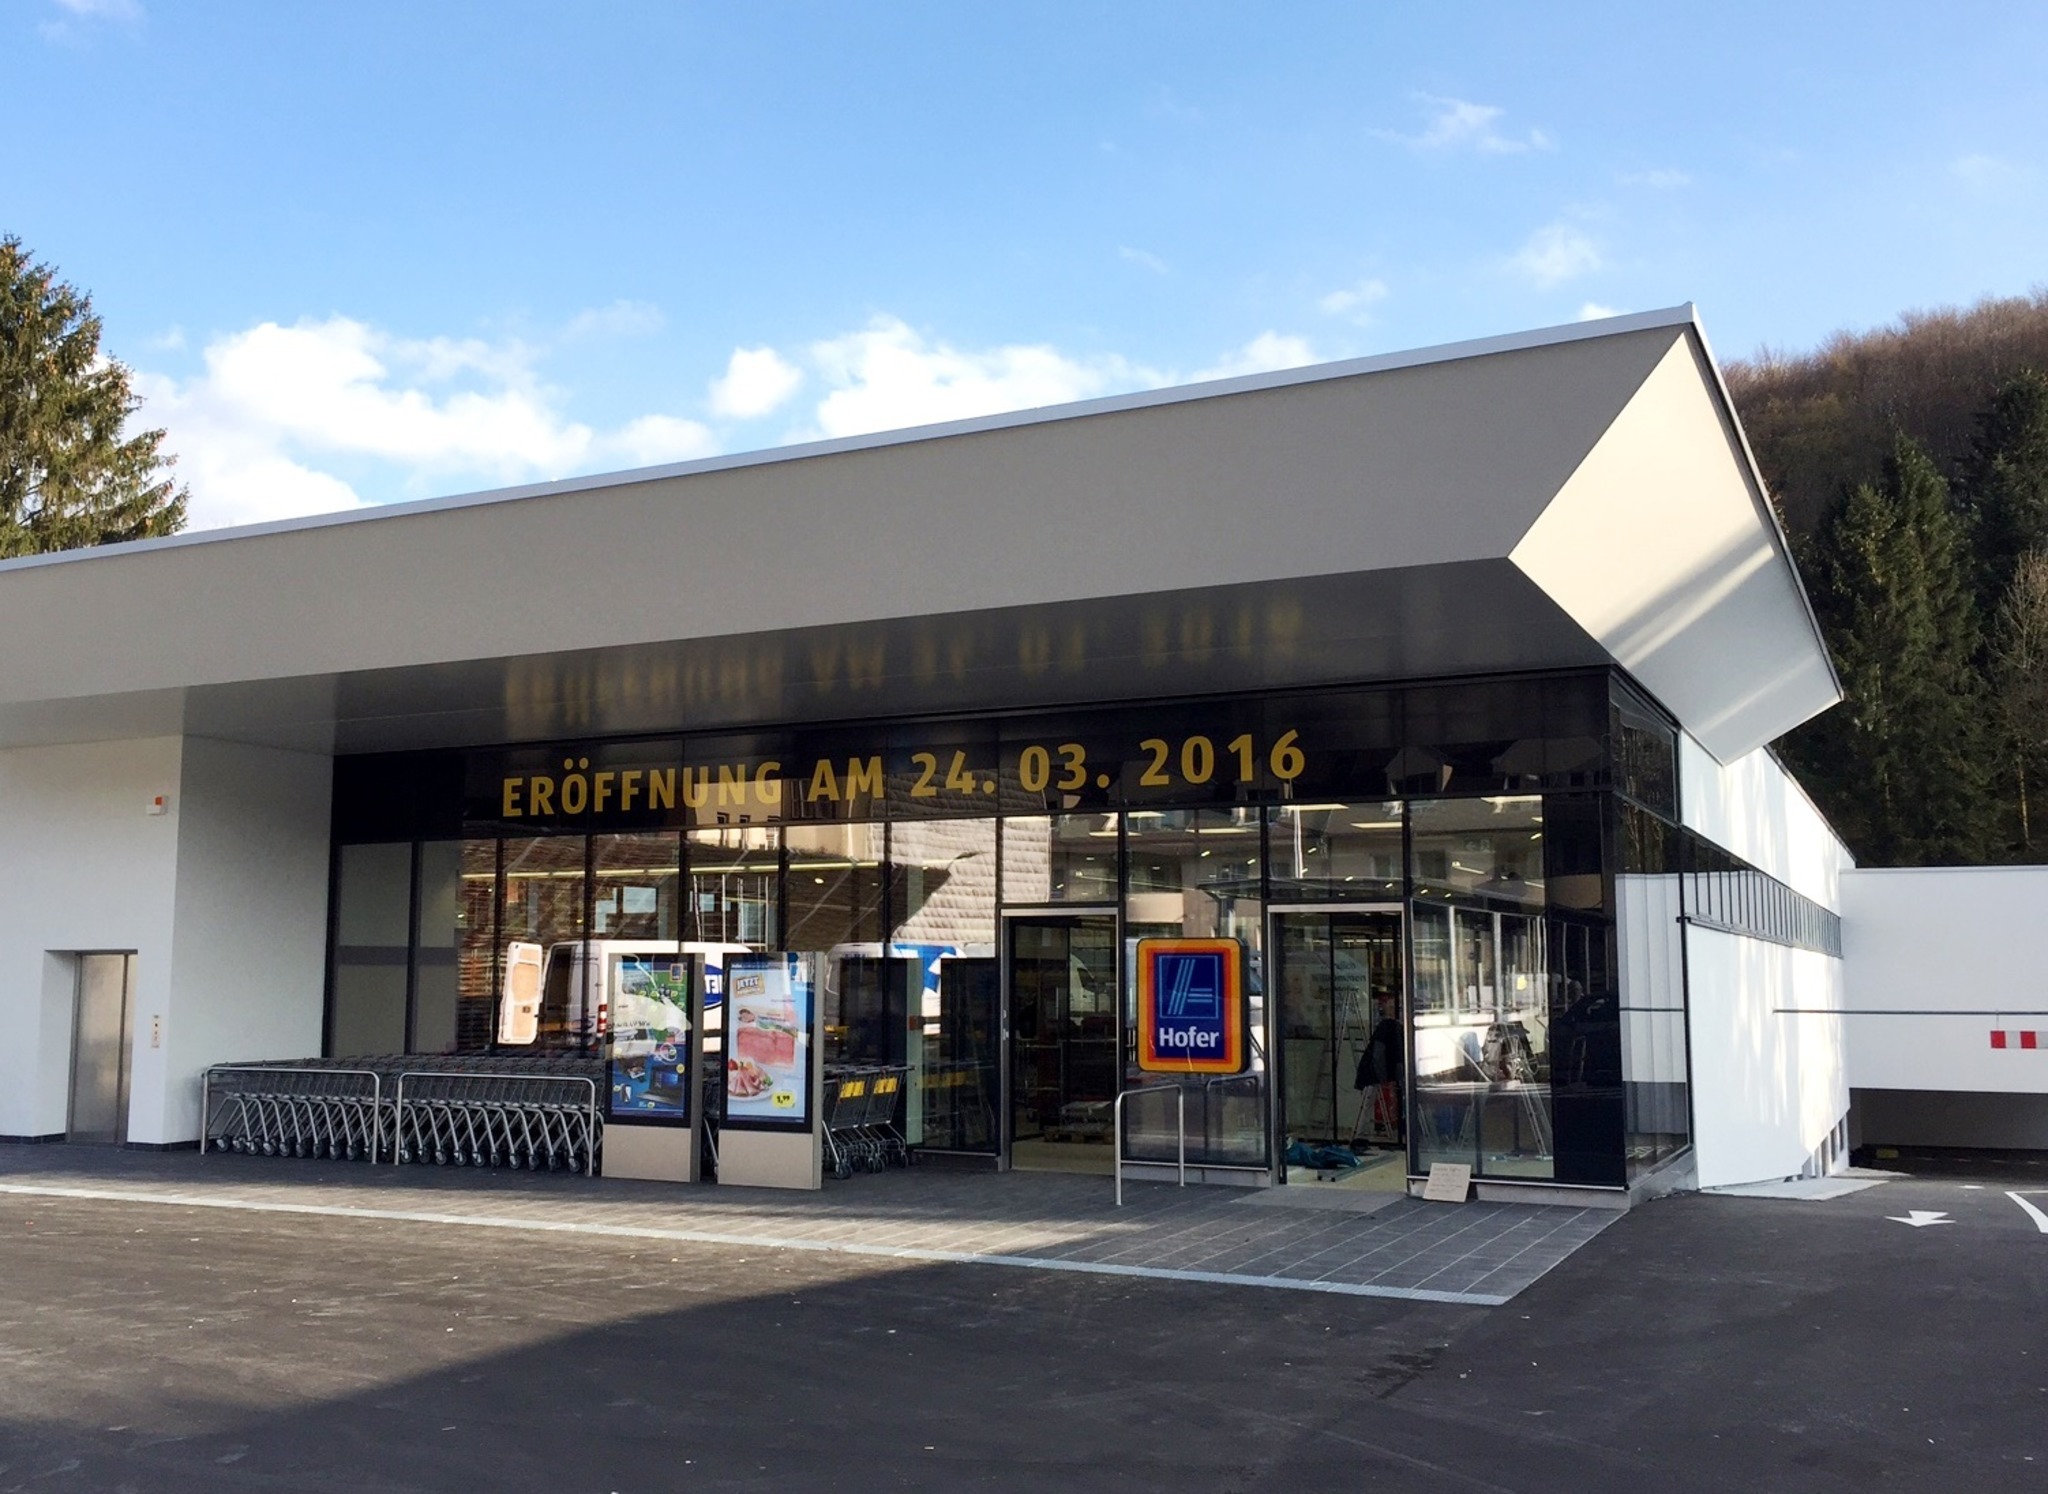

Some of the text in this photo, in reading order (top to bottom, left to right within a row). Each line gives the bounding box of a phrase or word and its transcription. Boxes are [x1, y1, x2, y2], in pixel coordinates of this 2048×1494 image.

[503, 729, 1306, 817] ERÖFFNUNG AM 24. 03. 2016
[1159, 1026, 1220, 1048] Hofer
